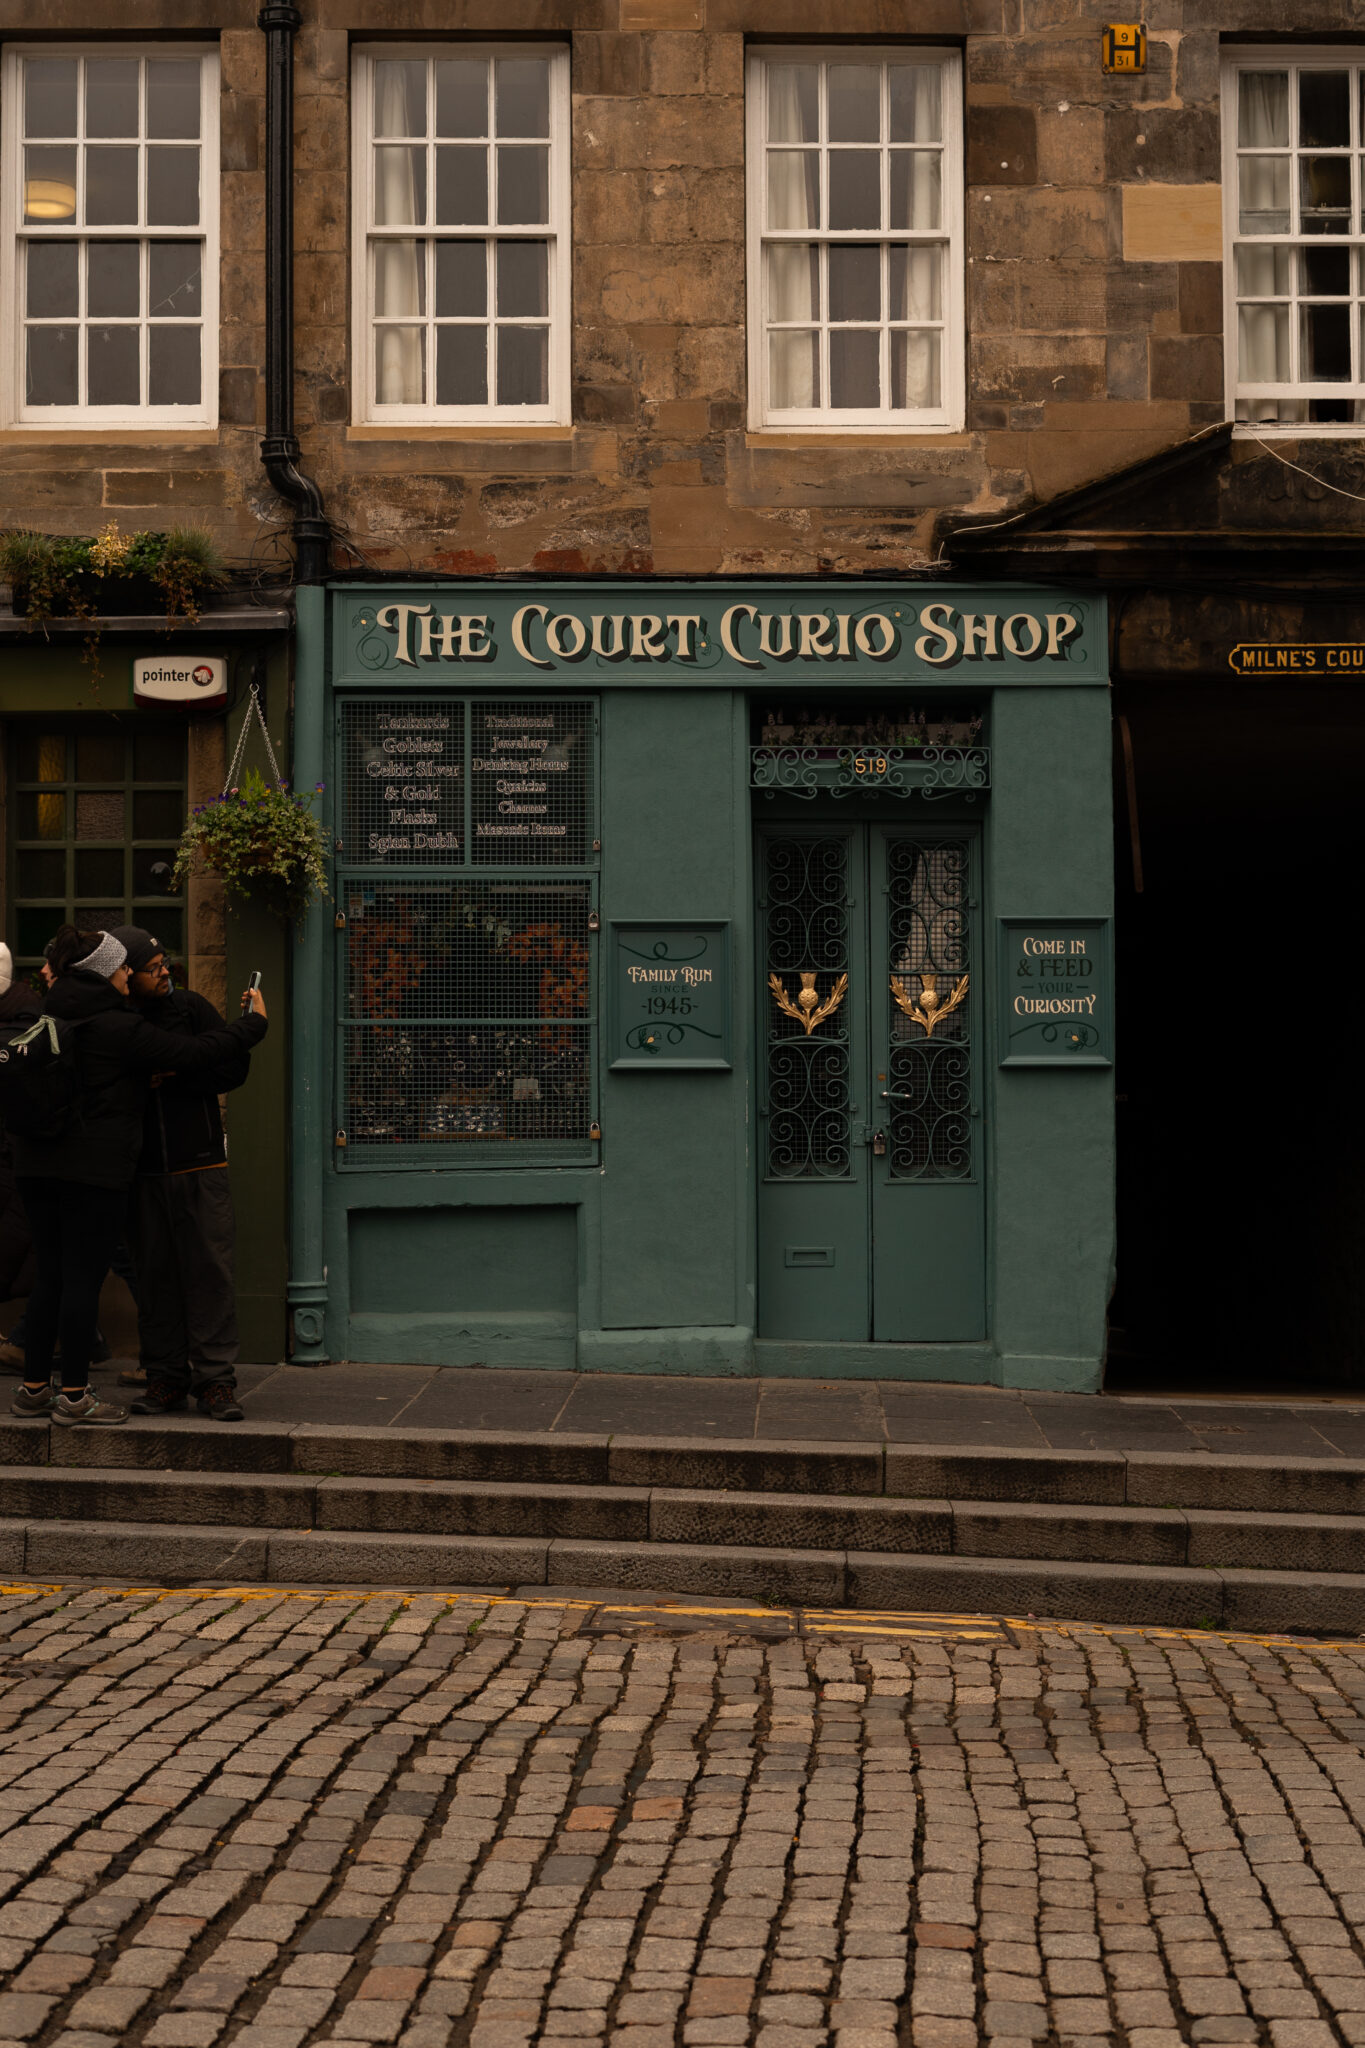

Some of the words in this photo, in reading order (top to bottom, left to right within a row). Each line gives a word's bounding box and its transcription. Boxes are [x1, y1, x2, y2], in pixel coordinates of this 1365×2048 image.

[1121, 32, 1128, 42] 9
[1109, 29, 1141, 67] H
[1116, 55, 1130, 66] 31
[376, 602, 497, 668] THE
[511, 602, 708, 670] COURT
[719, 602, 900, 670] CURIO
[914, 602, 1082, 668] SHOP
[1242, 649, 1317, 668] MILNE'S
[142, 667, 191, 684] pointer
[377, 713, 450, 729] Tankards
[484, 714, 555, 729] Traditional
[383, 736, 444, 753] Goblets
[490, 735, 549, 752] Jewellery
[366, 761, 413, 777] Celtic
[415, 761, 460, 777] Silver
[472, 757, 529, 774] Drinking
[529, 757, 569, 772] Horns
[854, 757, 888, 775] 519
[384, 785, 400, 801] &
[402, 784, 441, 801] Gold
[496, 779, 547, 795] Quaichs
[498, 800, 547, 814] Charms
[389, 808, 438, 825] Flasks
[476, 822, 529, 836] Masonic
[530, 822, 566, 836] Items
[368, 832, 411, 854] Sgian
[413, 832, 459, 848] Dubh
[1023, 937, 1066, 956] COME
[1070, 940, 1086, 955] IN
[1017, 959, 1035, 977] &
[1039, 958, 1094, 977] FEED
[627, 966, 678, 984] FAMILY
[681, 966, 713, 987] RUN
[651, 985, 689, 993] SINCE
[1038, 982, 1074, 993] YOUR
[1014, 993, 1097, 1016] CURIOSITY
